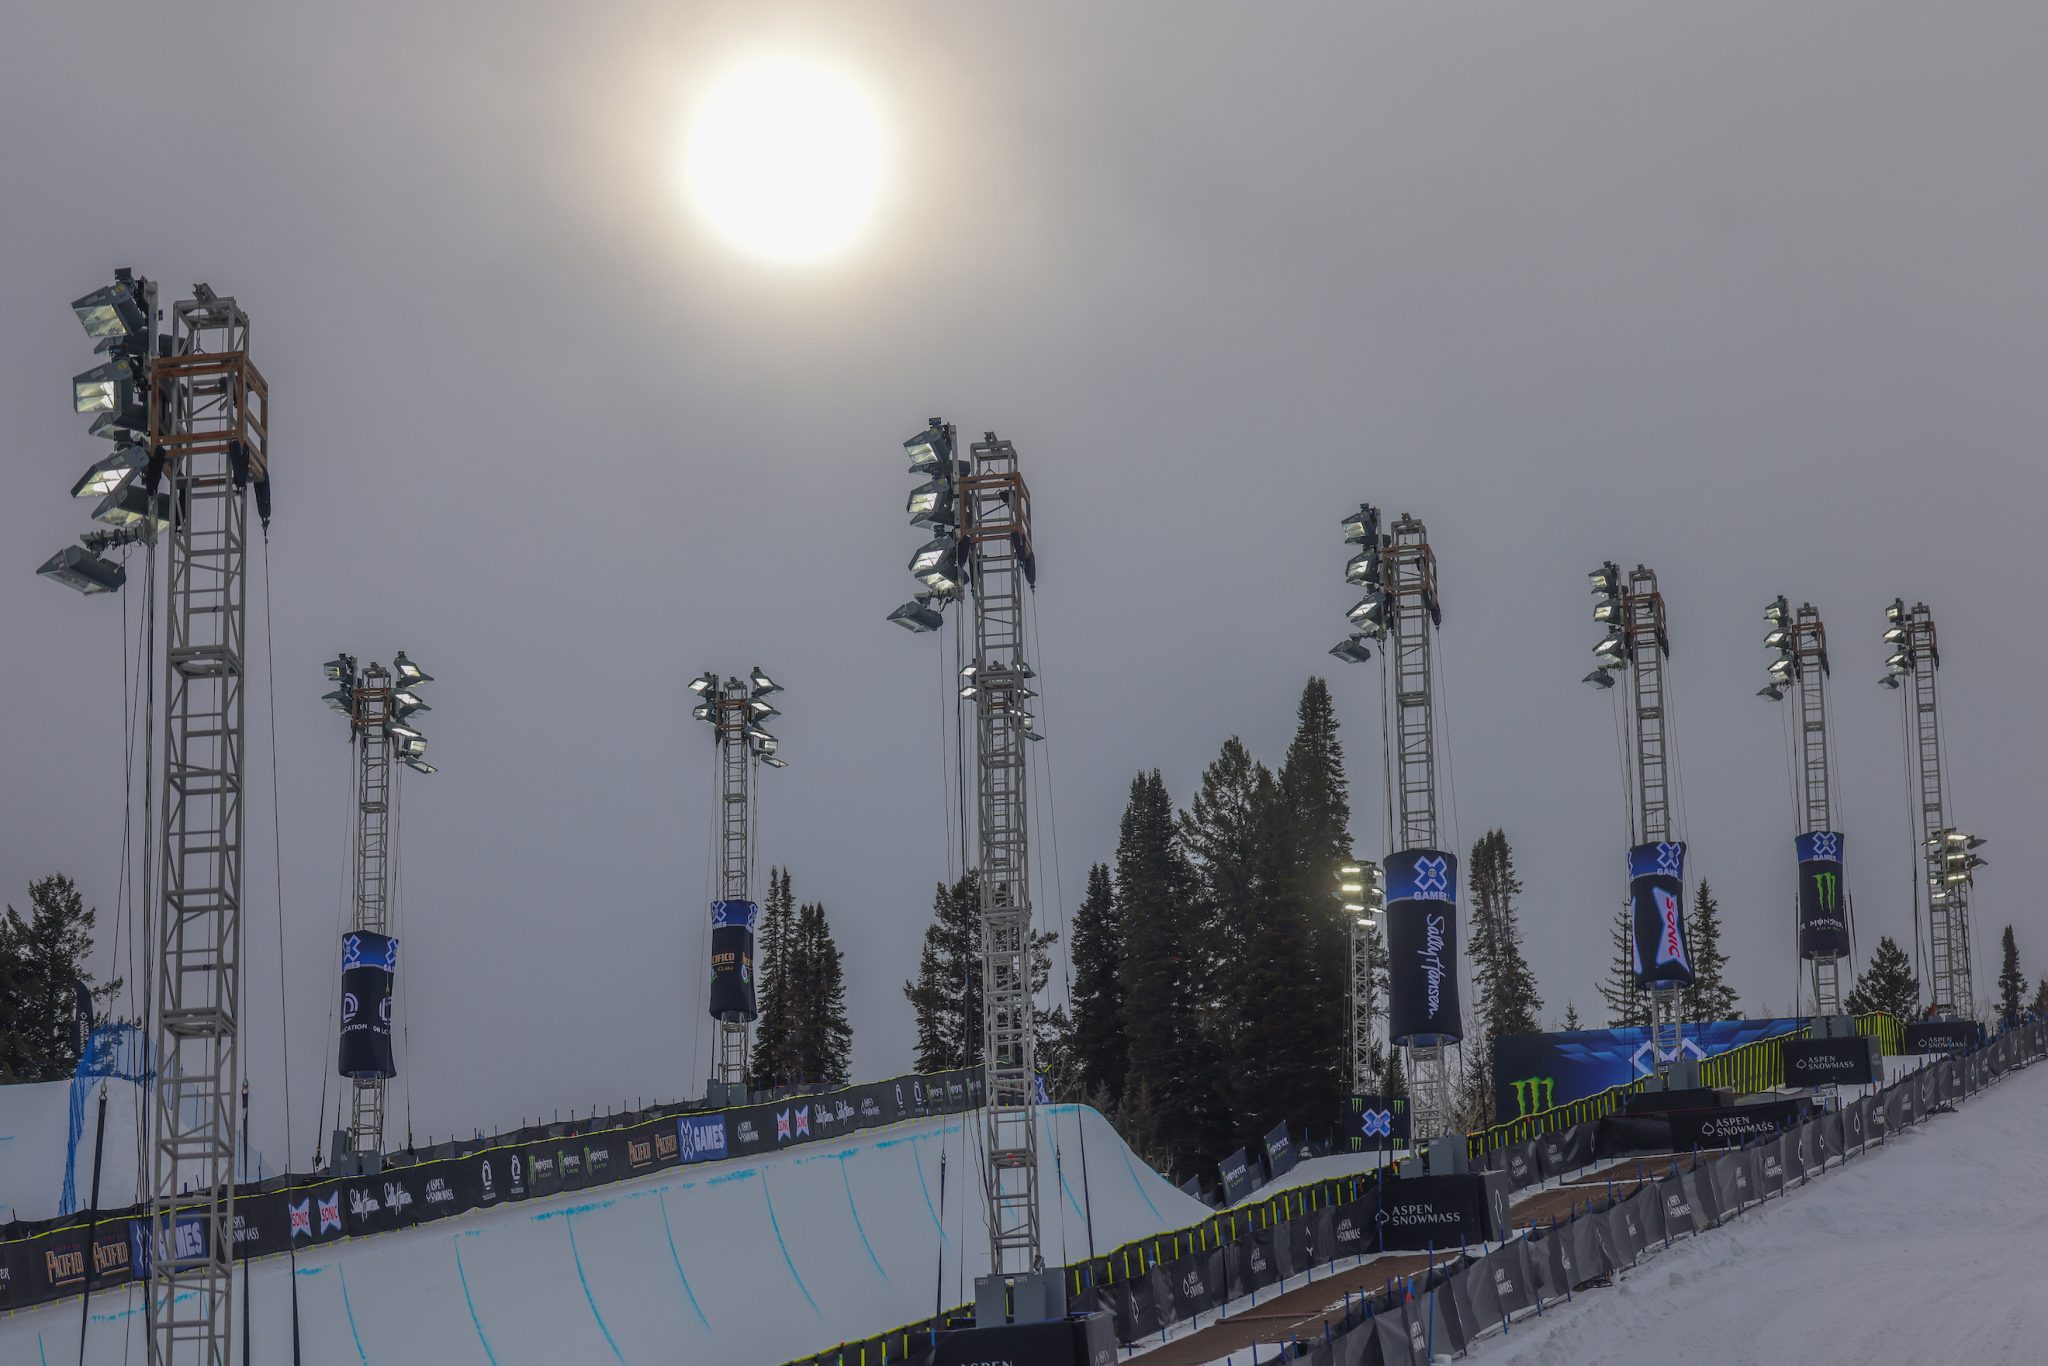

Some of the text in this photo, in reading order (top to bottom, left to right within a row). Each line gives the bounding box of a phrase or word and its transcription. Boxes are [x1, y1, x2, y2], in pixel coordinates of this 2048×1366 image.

[1417, 913, 1445, 957] Sally
[1665, 896, 1680, 958] SONIC
[1808, 1055, 1836, 1064] ASPEN
[1808, 1060, 1854, 1070] SNOWMASS
[1716, 1116, 1750, 1127] ASPEN
[1717, 1121, 1774, 1137] SNOWMASS
[694, 1123, 725, 1152] GAMES
[321, 1205, 338, 1222] SONIC
[1392, 1204, 1433, 1216] ASPEN
[292, 1211, 309, 1227] SONIC
[1392, 1212, 1461, 1226] SNOWMASS
